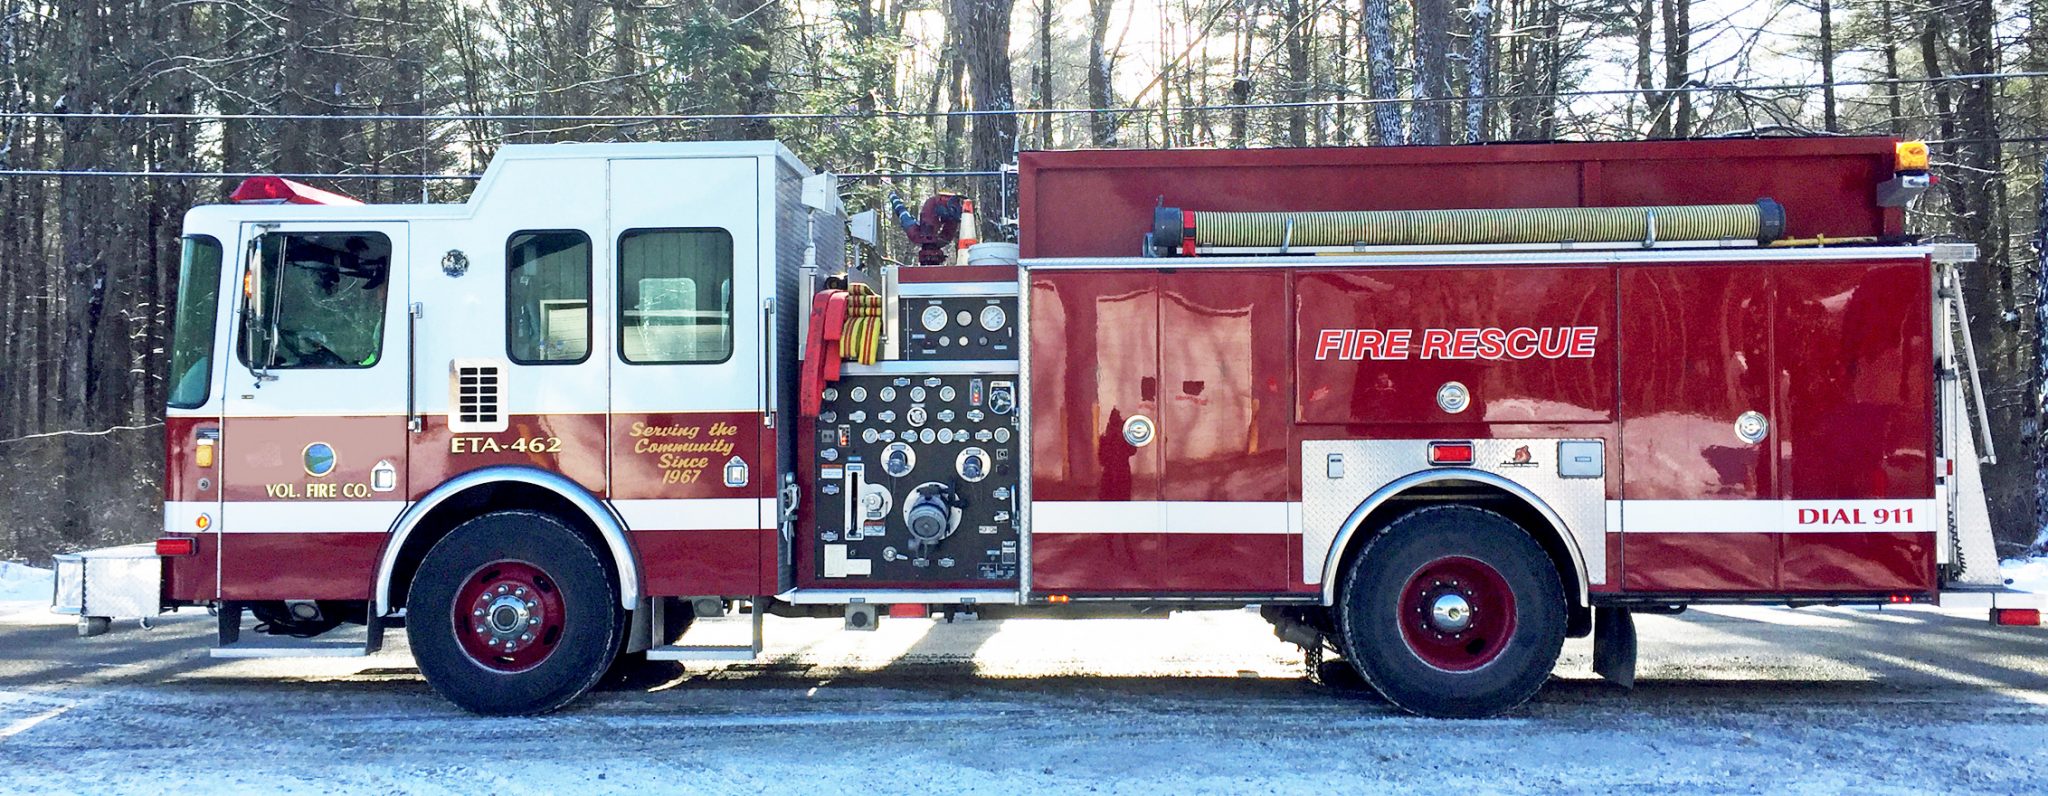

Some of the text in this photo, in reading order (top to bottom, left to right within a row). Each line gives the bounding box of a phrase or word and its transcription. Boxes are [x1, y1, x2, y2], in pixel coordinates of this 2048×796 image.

[1315, 327, 1599, 360] FIRE RESCUE
[629, 421, 737, 439] Serving the
[451, 437, 562, 453] ETA-462
[634, 438, 735, 456] Community
[658, 453, 708, 469] Since
[662, 469, 701, 484] 1967
[266, 484, 371, 498] VOL. FIRE CO.
[1798, 508, 1914, 525] DIAL 911
